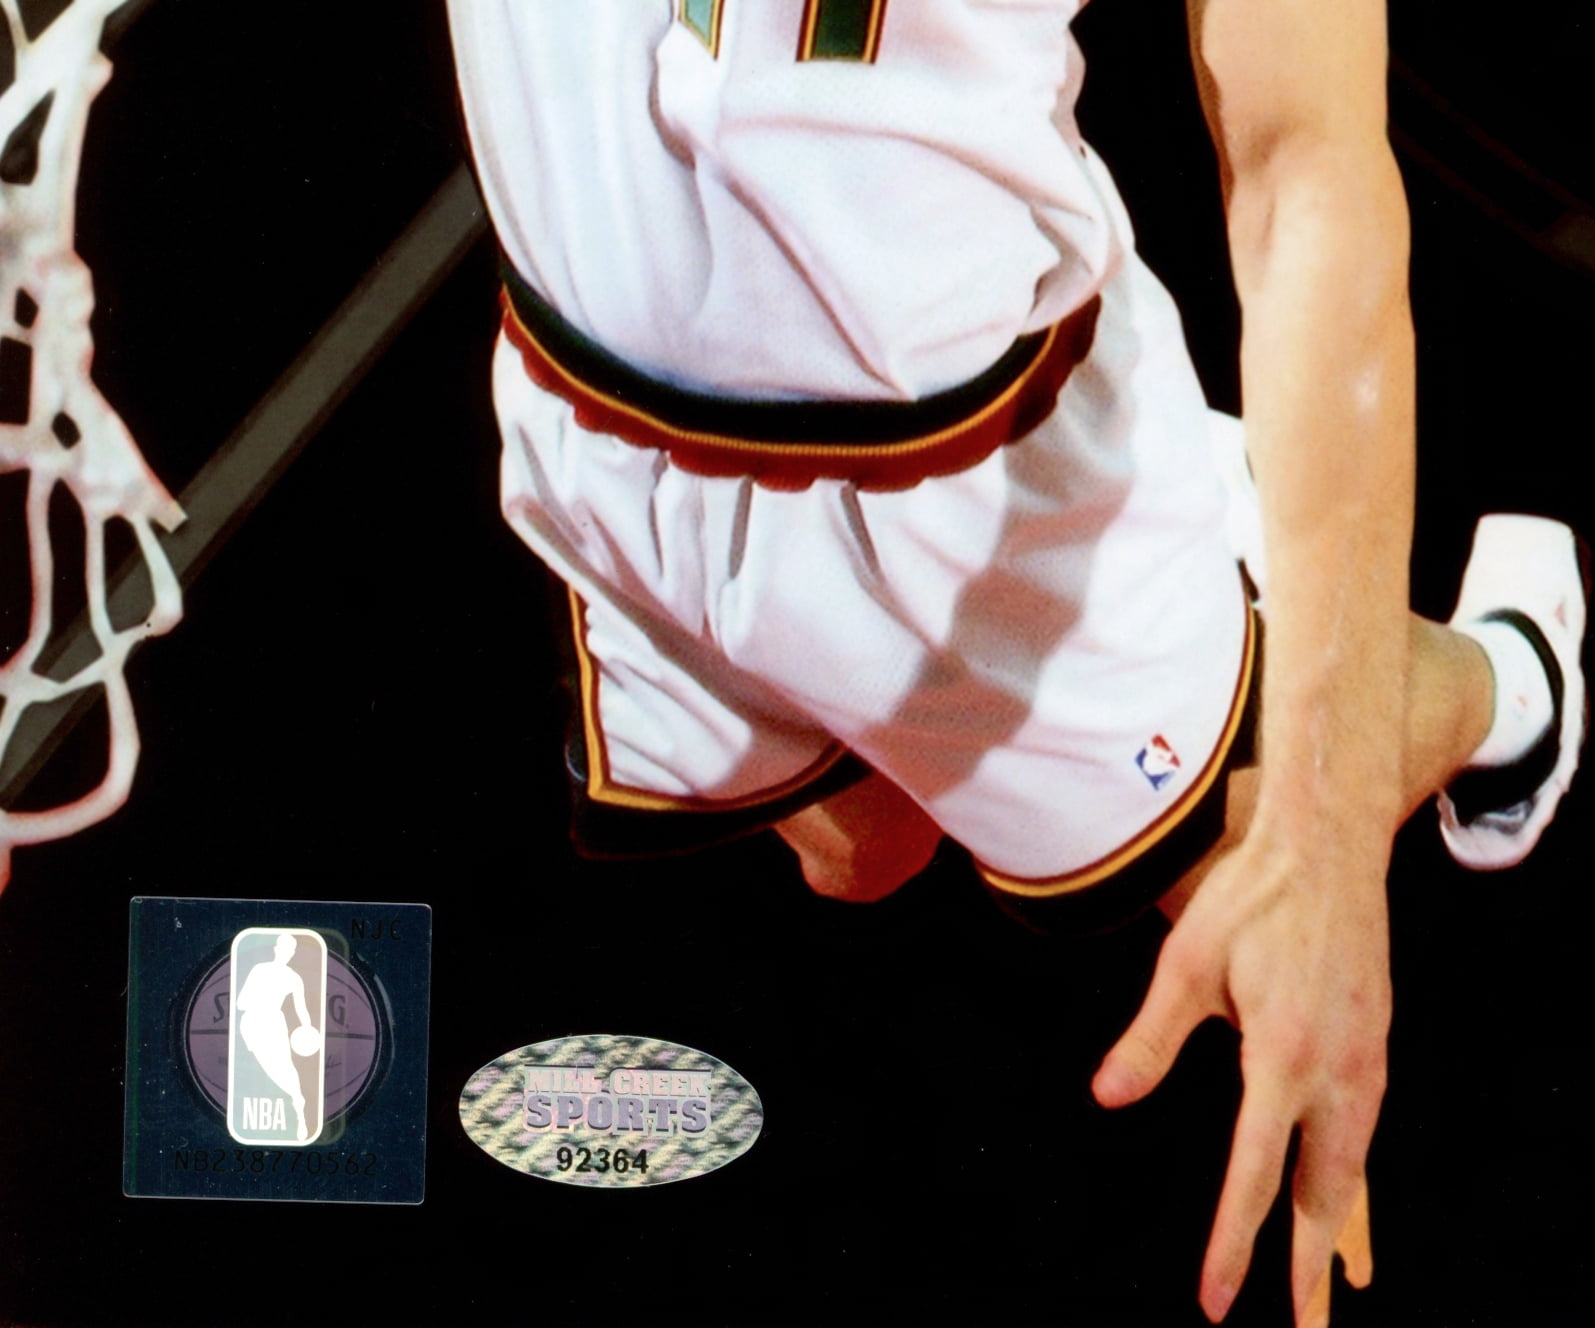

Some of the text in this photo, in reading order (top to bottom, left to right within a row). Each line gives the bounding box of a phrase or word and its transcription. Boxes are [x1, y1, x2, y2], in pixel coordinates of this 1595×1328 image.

[526, 1069, 711, 1097] MILL CREEK
[243, 1097, 287, 1131] NBA
[526, 1095, 707, 1133] SPORTS
[556, 1147, 649, 1174] 92364
